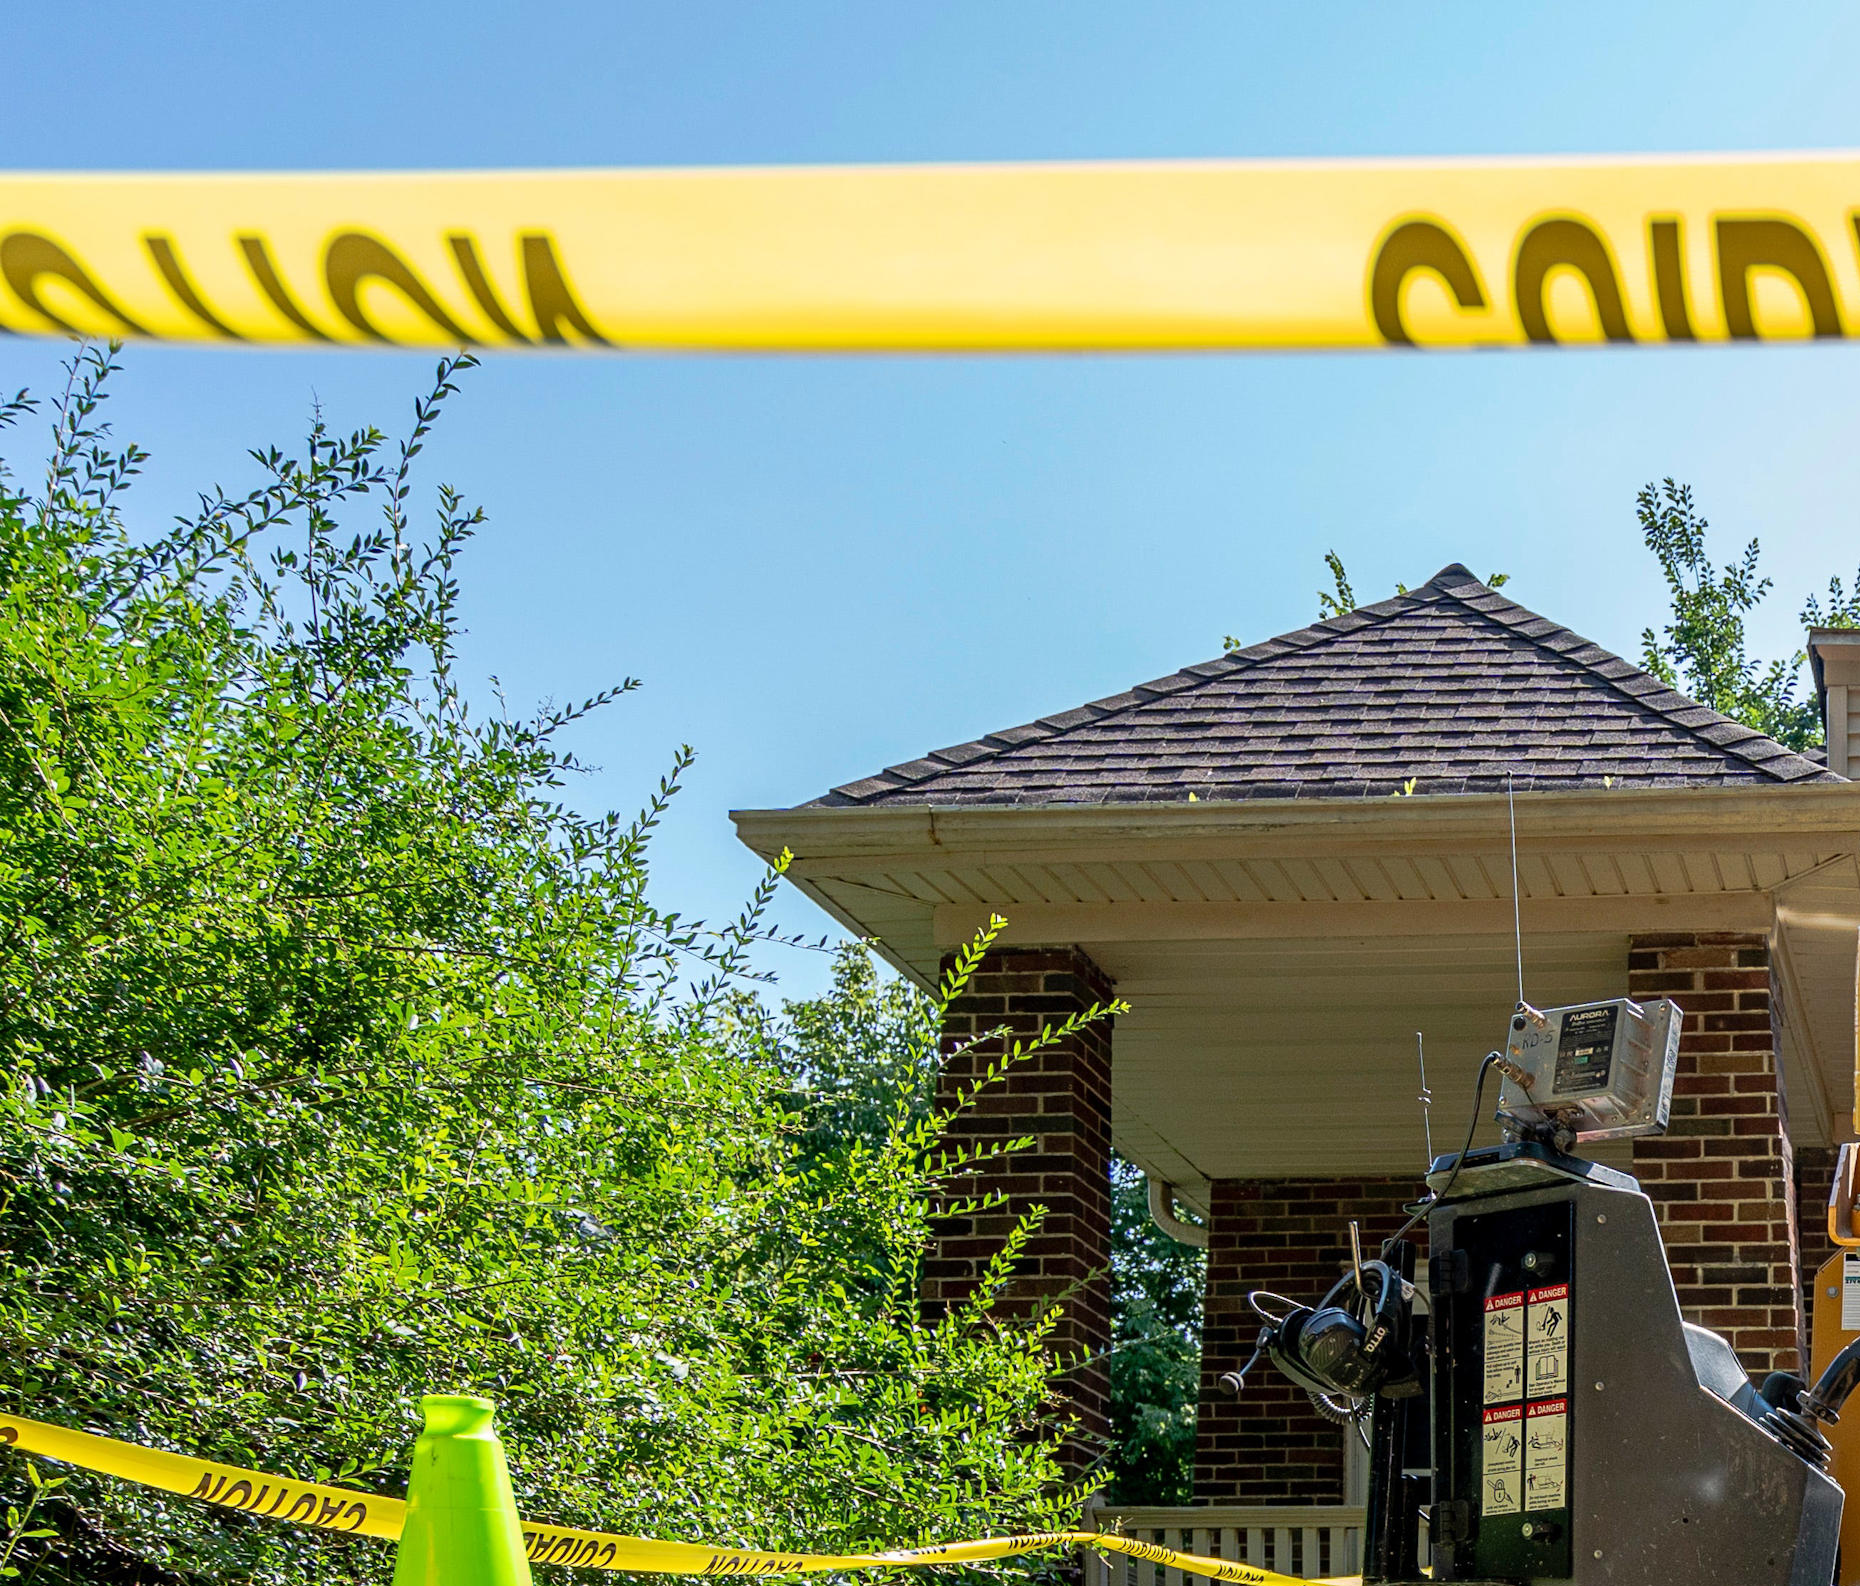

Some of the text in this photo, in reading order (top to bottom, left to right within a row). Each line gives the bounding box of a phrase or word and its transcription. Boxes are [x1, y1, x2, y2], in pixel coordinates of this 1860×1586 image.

[1569, 1009, 1609, 1022] AURORA
[1538, 1287, 1567, 1300] DANGER
[1494, 1295, 1522, 1308] DANGER
[1366, 1326, 1386, 1353] OTTO
[1493, 1408, 1521, 1421] DANGER
[1537, 1402, 1565, 1415] DANGER
[189, 1472, 367, 1532] CAUTION
[702, 1553, 804, 1576] CAUTION
